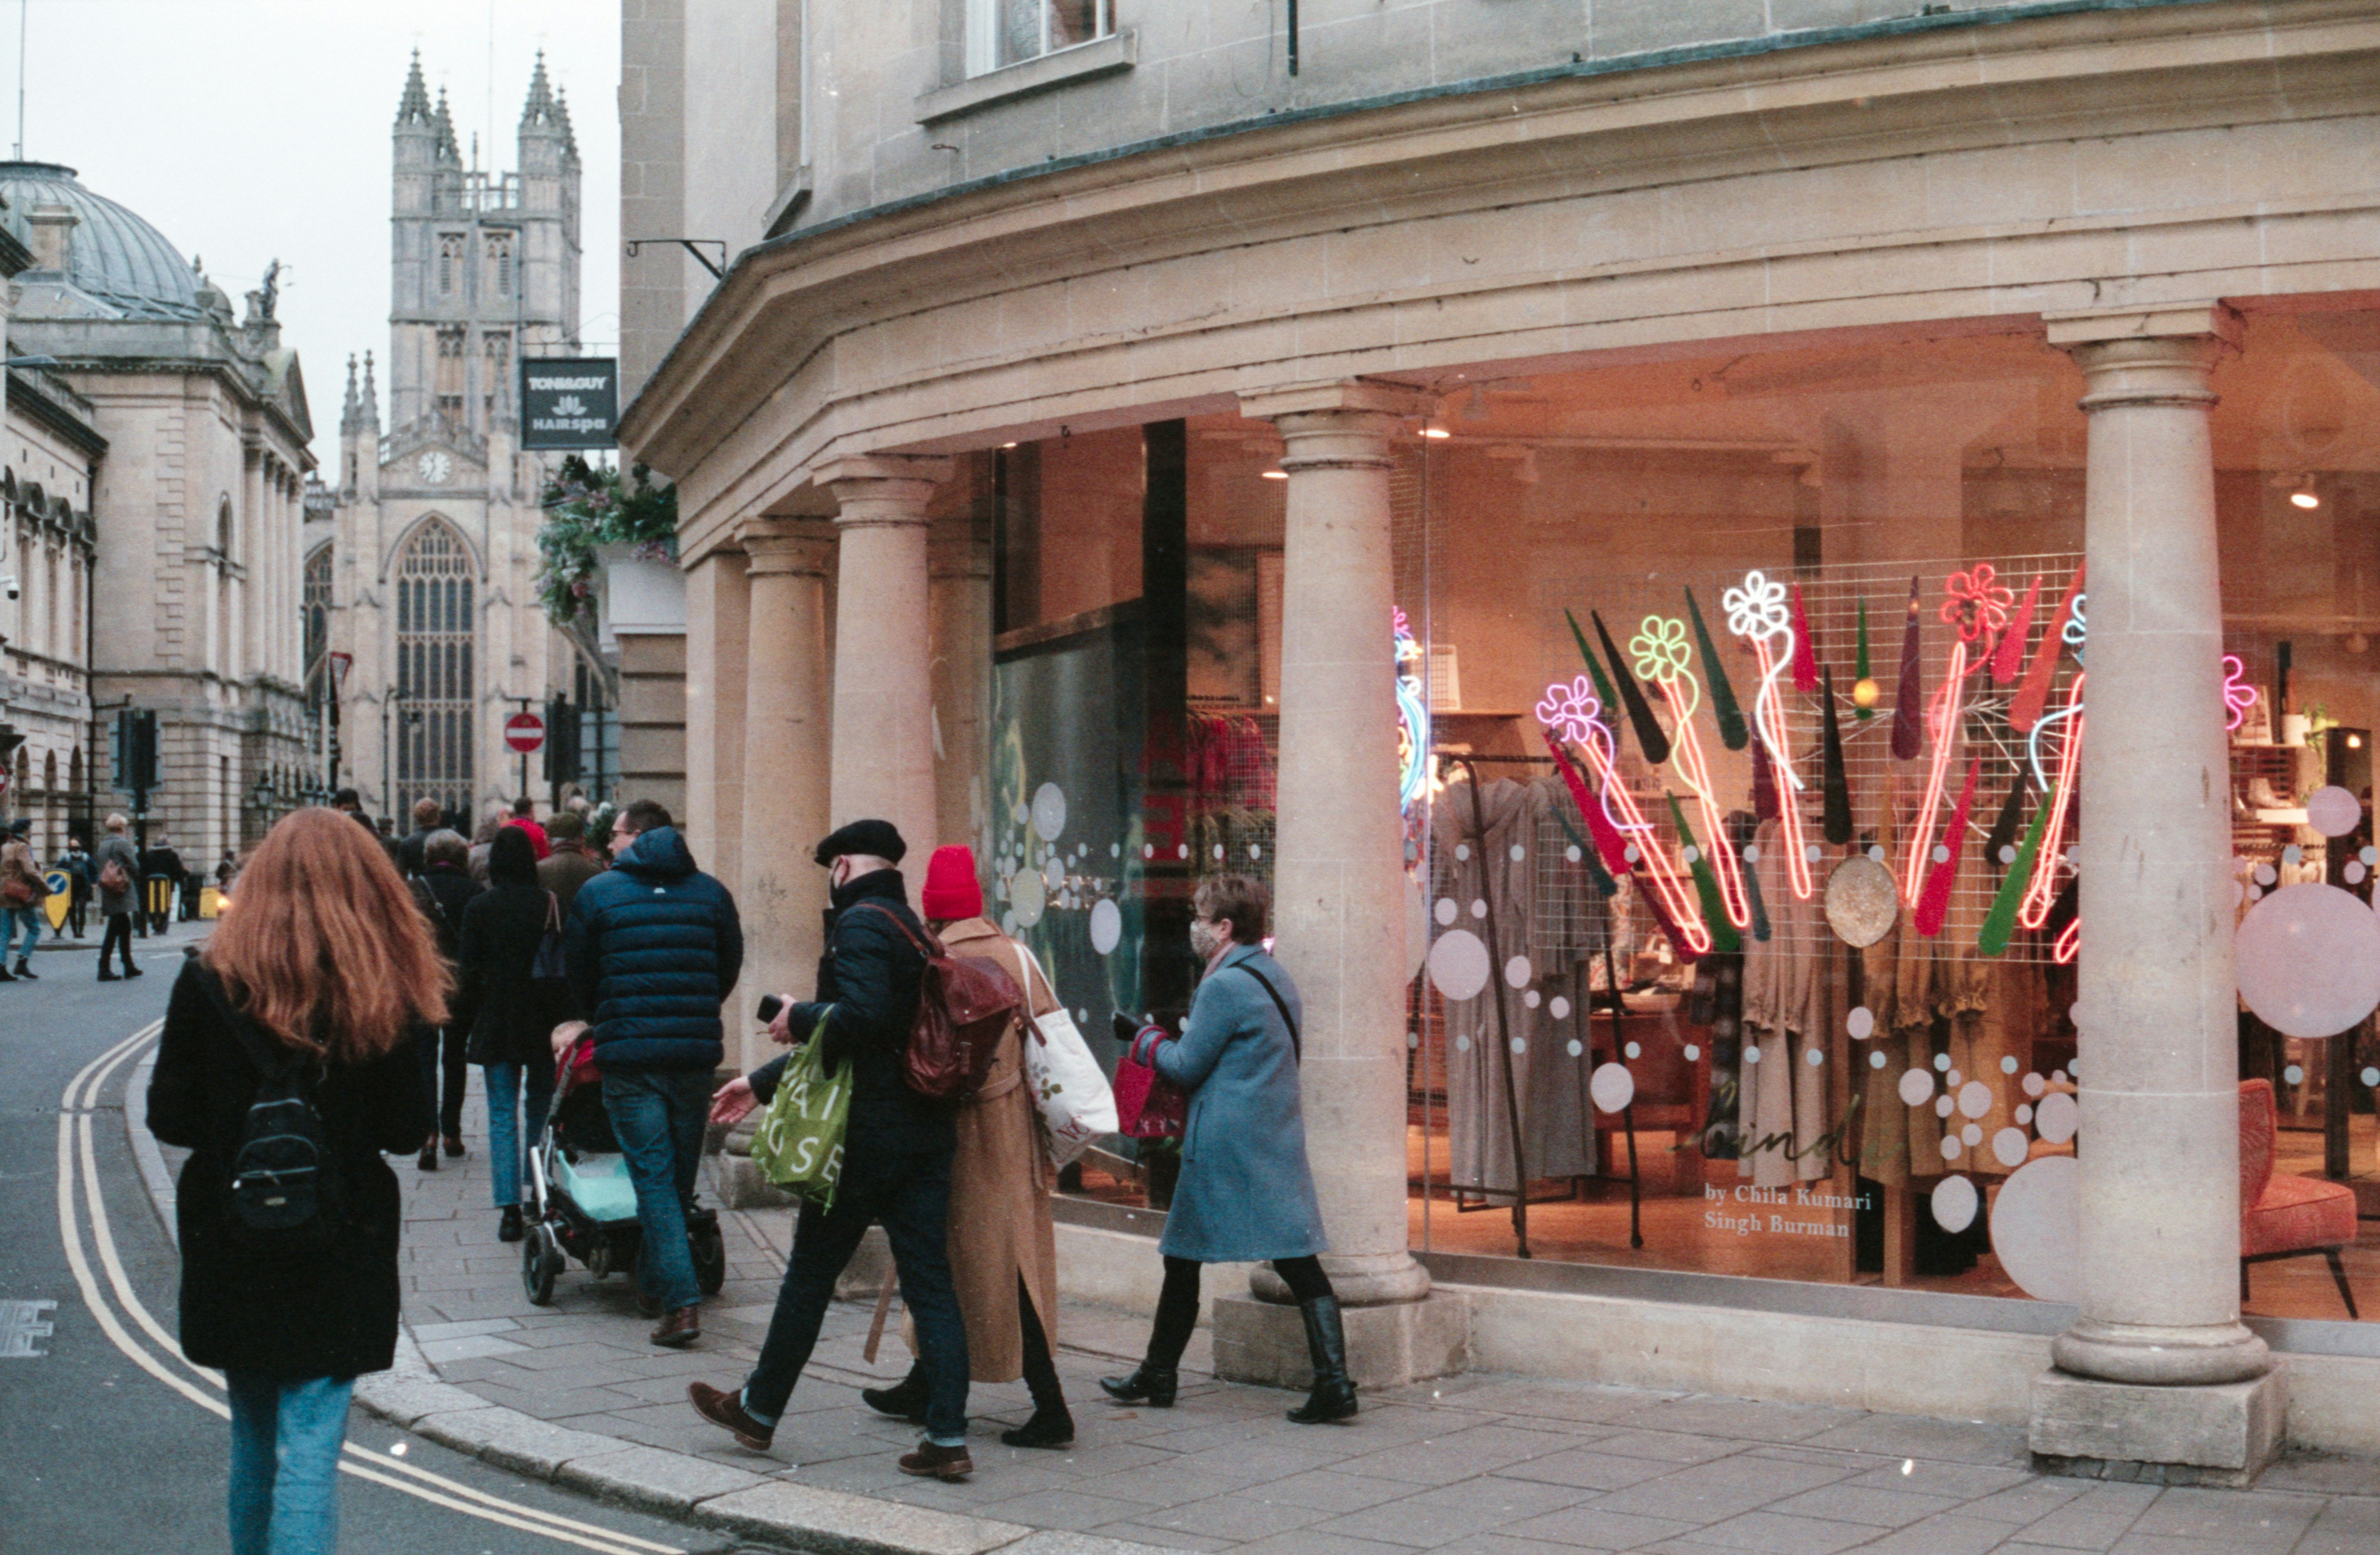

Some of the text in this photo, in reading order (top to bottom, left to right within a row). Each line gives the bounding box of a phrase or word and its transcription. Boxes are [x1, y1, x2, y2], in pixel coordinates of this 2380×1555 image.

[528, 377, 607, 390] TONI&GUY
[1705, 1183, 1872, 1210] by Chila Kumari
[1705, 1211, 1849, 1237] Singh Burman
